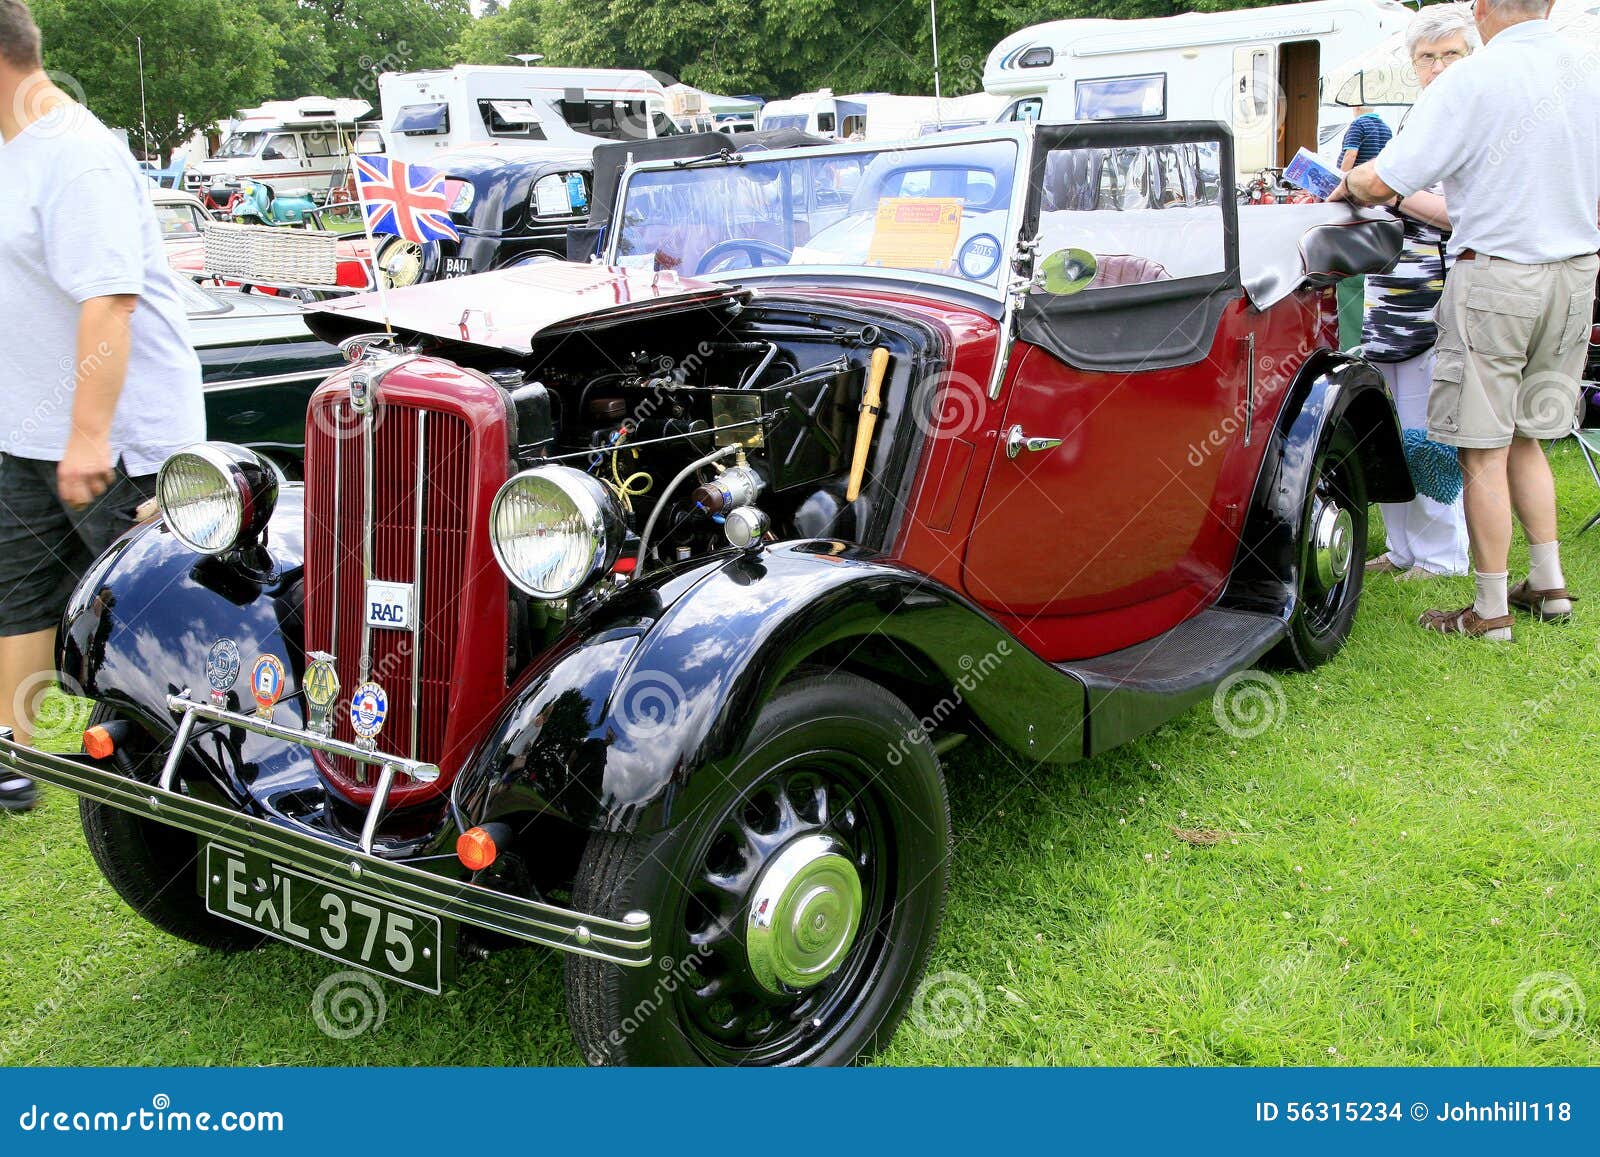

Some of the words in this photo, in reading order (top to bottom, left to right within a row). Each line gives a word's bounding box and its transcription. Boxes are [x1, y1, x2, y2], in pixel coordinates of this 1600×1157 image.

[971, 244, 994, 257] 2015
[446, 258, 468, 272] BAU
[371, 602, 403, 622] RAC
[227, 857, 310, 940] EXL
[319, 892, 414, 973] 375
